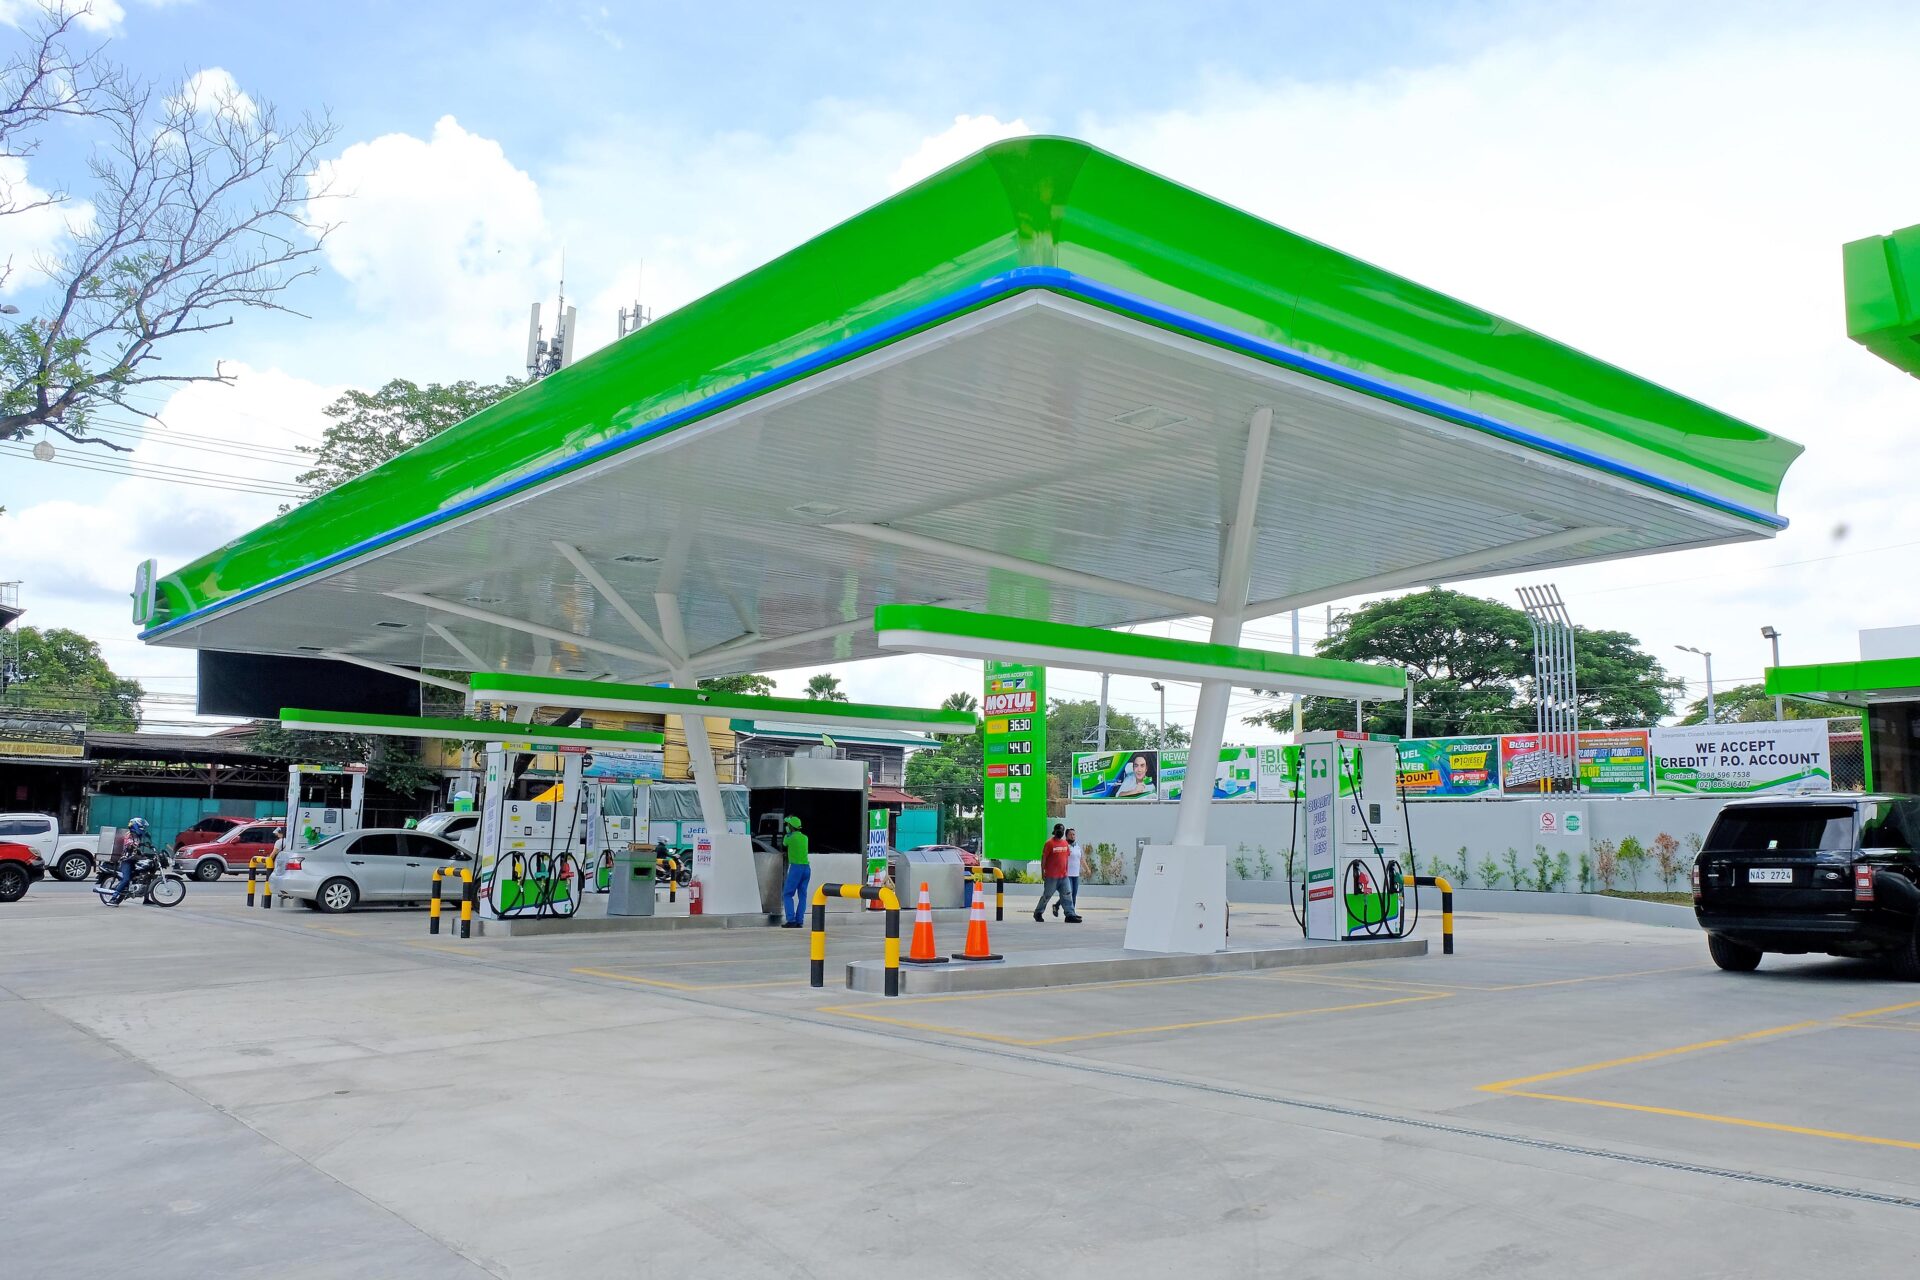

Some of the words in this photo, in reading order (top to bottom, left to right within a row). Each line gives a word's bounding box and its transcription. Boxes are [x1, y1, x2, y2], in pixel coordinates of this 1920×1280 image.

[986, 692, 1034, 710] MOTUL
[1010, 719, 1030, 731] 36.30
[1009, 741, 1030, 753] 44.10
[1696, 742, 1716, 754] WE
[1720, 740, 1776, 752] ACCEPT
[1463, 756, 1484, 764] DIESEL
[1660, 756, 1708, 768] CREDIT
[1720, 755, 1744, 766] P.O.
[1749, 752, 1820, 766] ACCOUNT
[1009, 764, 1030, 776] 45.10
[1078, 760, 1098, 774] FREE
[1261, 764, 1287, 773] TICKE
[1396, 762, 1424, 771] AVER
[1588, 766, 1600, 777] OFF
[1697, 781, 1712, 789] (02)
[1351, 804, 1356, 815] 8
[1313, 811, 1326, 825] FUEL
[870, 831, 886, 844] NOW
[1314, 826, 1326, 840] FOR
[1314, 841, 1327, 855] LESS
[1750, 871, 1765, 880] NAS
[1771, 871, 1790, 879] 2724
